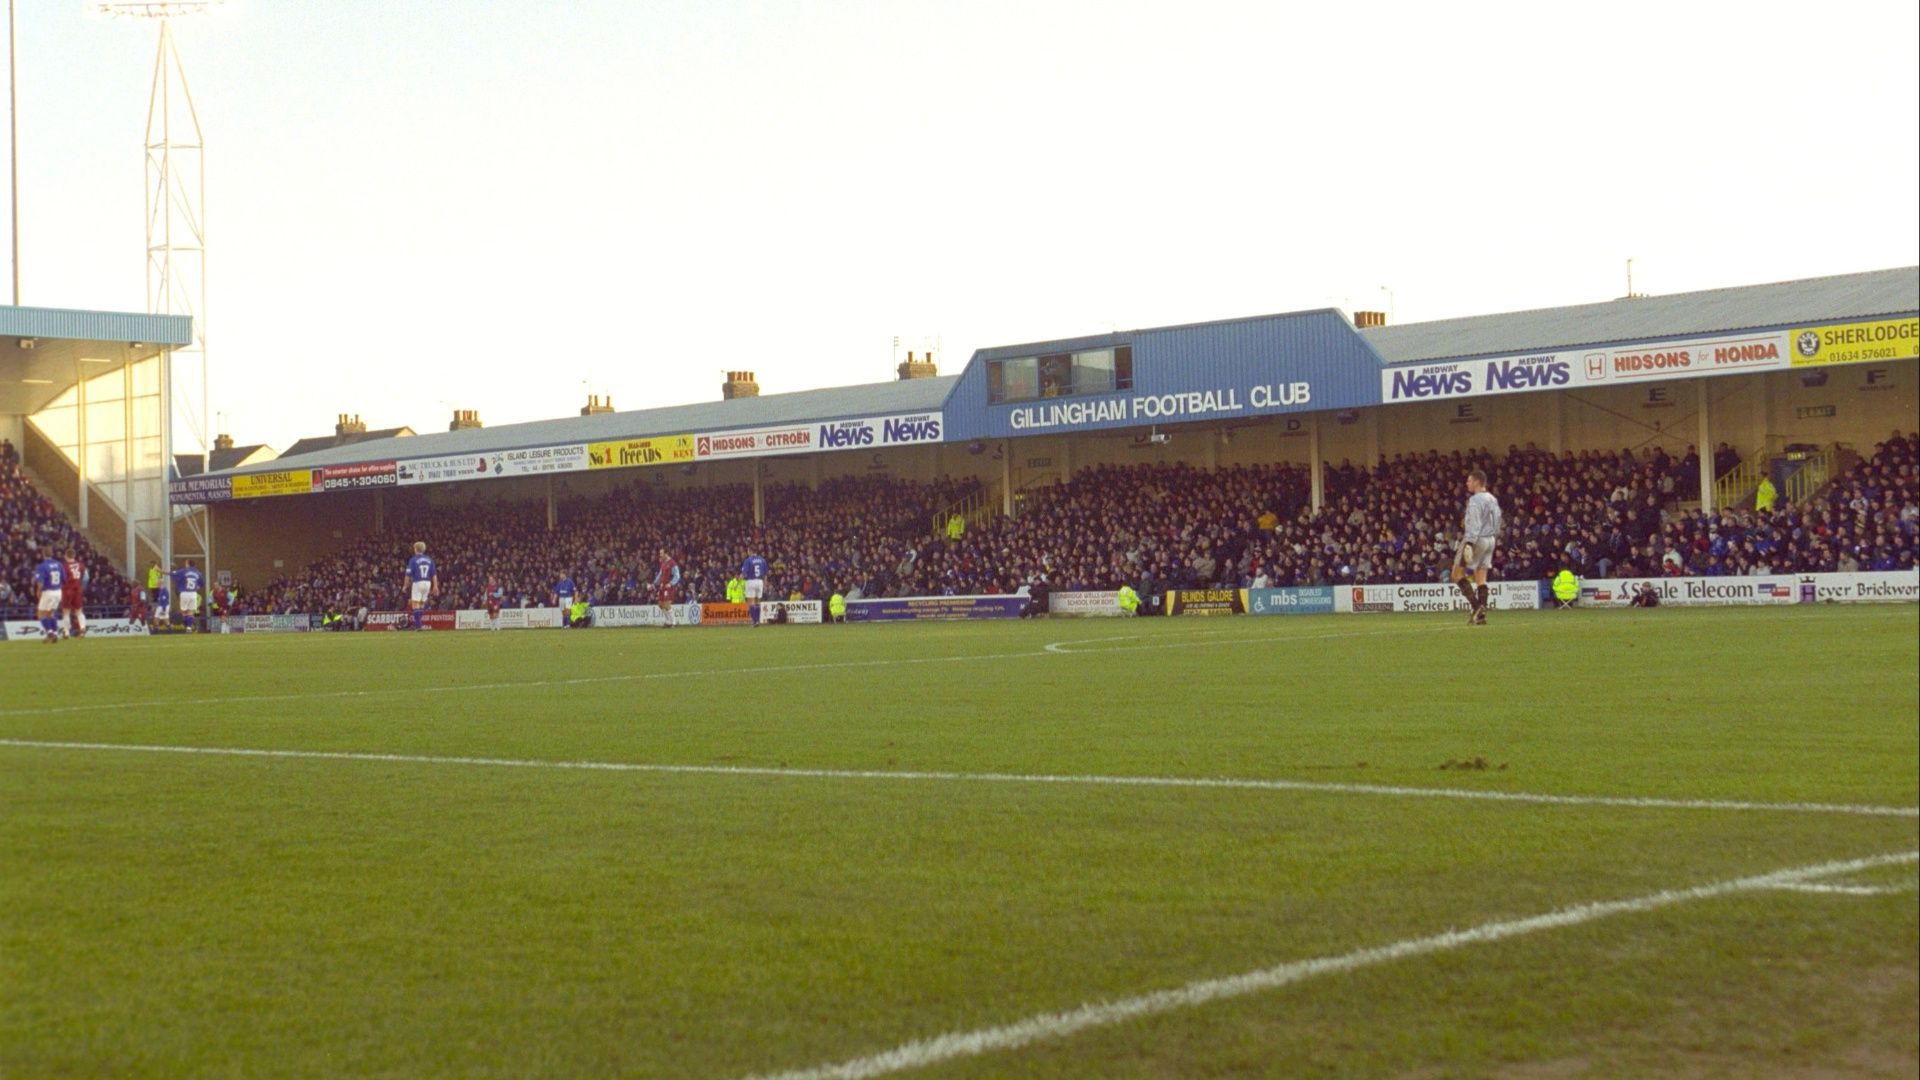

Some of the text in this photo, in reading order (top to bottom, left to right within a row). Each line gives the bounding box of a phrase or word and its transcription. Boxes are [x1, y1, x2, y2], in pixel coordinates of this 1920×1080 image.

[1824, 323, 1918, 346] SHERLODGE
[1518, 355, 1556, 366] MEDWAY
[1614, 351, 1691, 372] HIDSONS
[1714, 343, 1779, 364] HONDA
[1829, 350, 1859, 362] 01634
[1862, 347, 1897, 360] 576021
[1422, 364, 1458, 374] MEDWAY
[1485, 360, 1570, 391] News
[1392, 369, 1472, 399] News
[1010, 382, 1311, 429] GILLINGHAM FOOTBALL CLUB
[819, 424, 874, 448] News
[883, 418, 940, 443] News
[712, 436, 755, 451] HIDSONS
[765, 432, 811, 446] CITROËN
[507, 452, 527, 461] ISLAND
[529, 449, 551, 459] LEISURE
[553, 447, 584, 457] PRODUCTS
[604, 448, 613, 464] 1
[250, 473, 293, 485] UNIVERSAL
[419, 564, 430, 579] 17
[754, 565, 761, 577] 5
[1182, 590, 1233, 603] BLINDS GALORE
[1271, 589, 1298, 605] mbs
[1398, 587, 1445, 598] Contract
[1632, 580, 1754, 599] Sale Telecom
[771, 602, 818, 612] PSONNEL
[1403, 600, 1450, 611] Services
